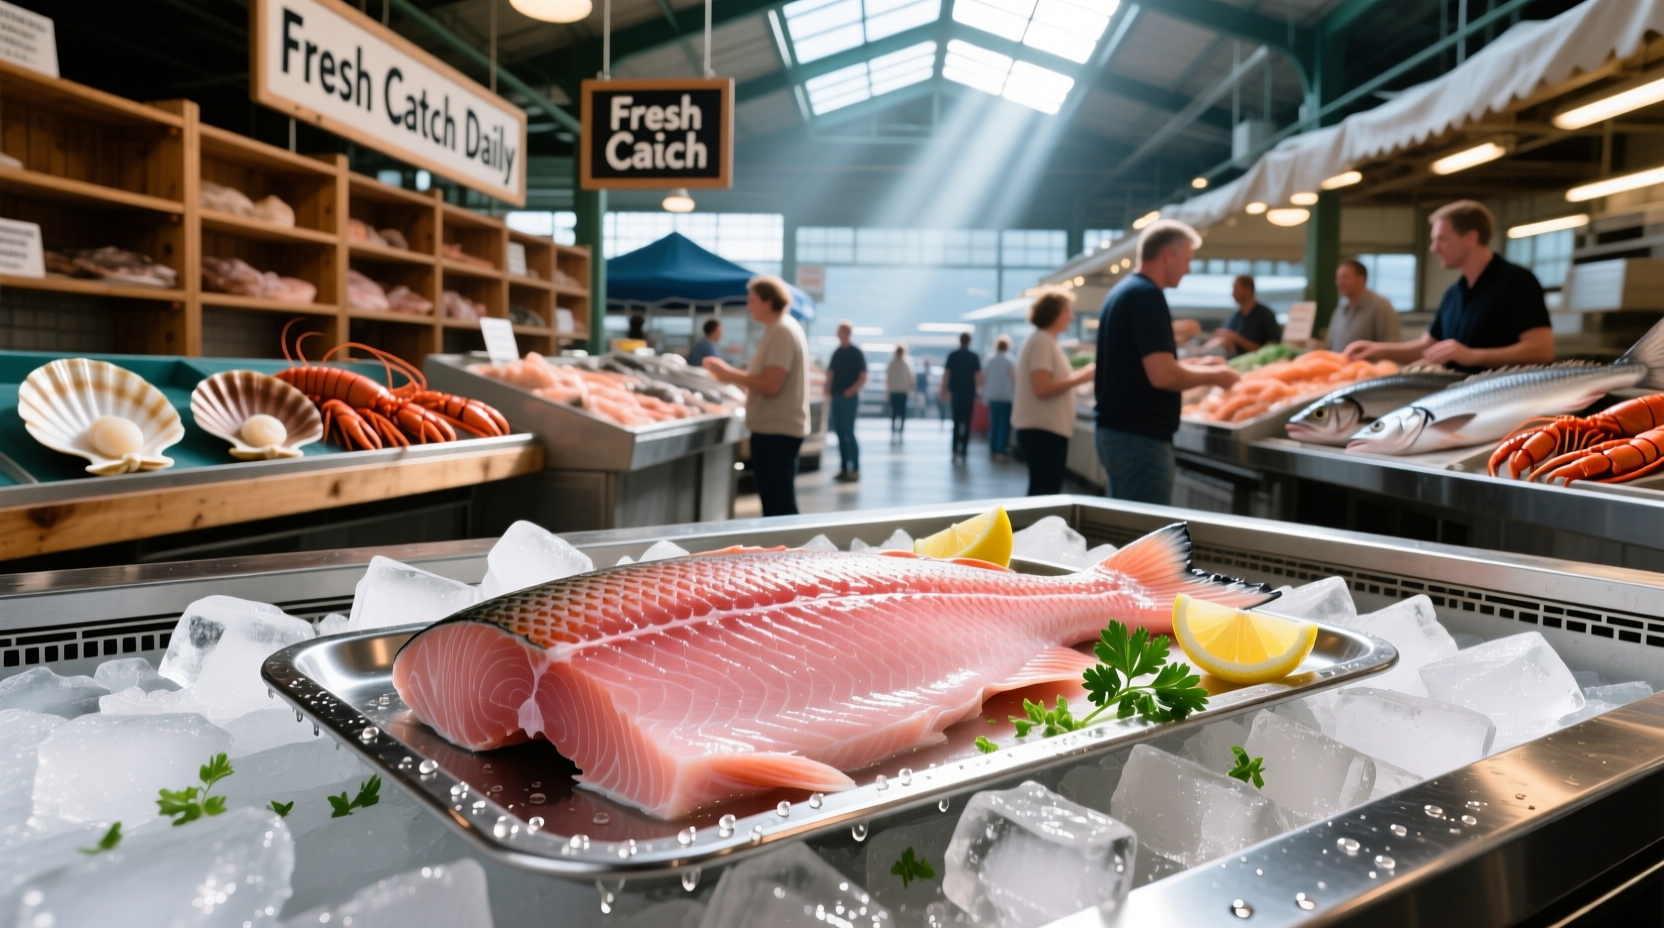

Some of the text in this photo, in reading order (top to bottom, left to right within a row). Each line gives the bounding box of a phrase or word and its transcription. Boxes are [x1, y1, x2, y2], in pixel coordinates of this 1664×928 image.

[281, 7, 515, 185] Fresh Catch Daily
[610, 93, 702, 131] Fresh
